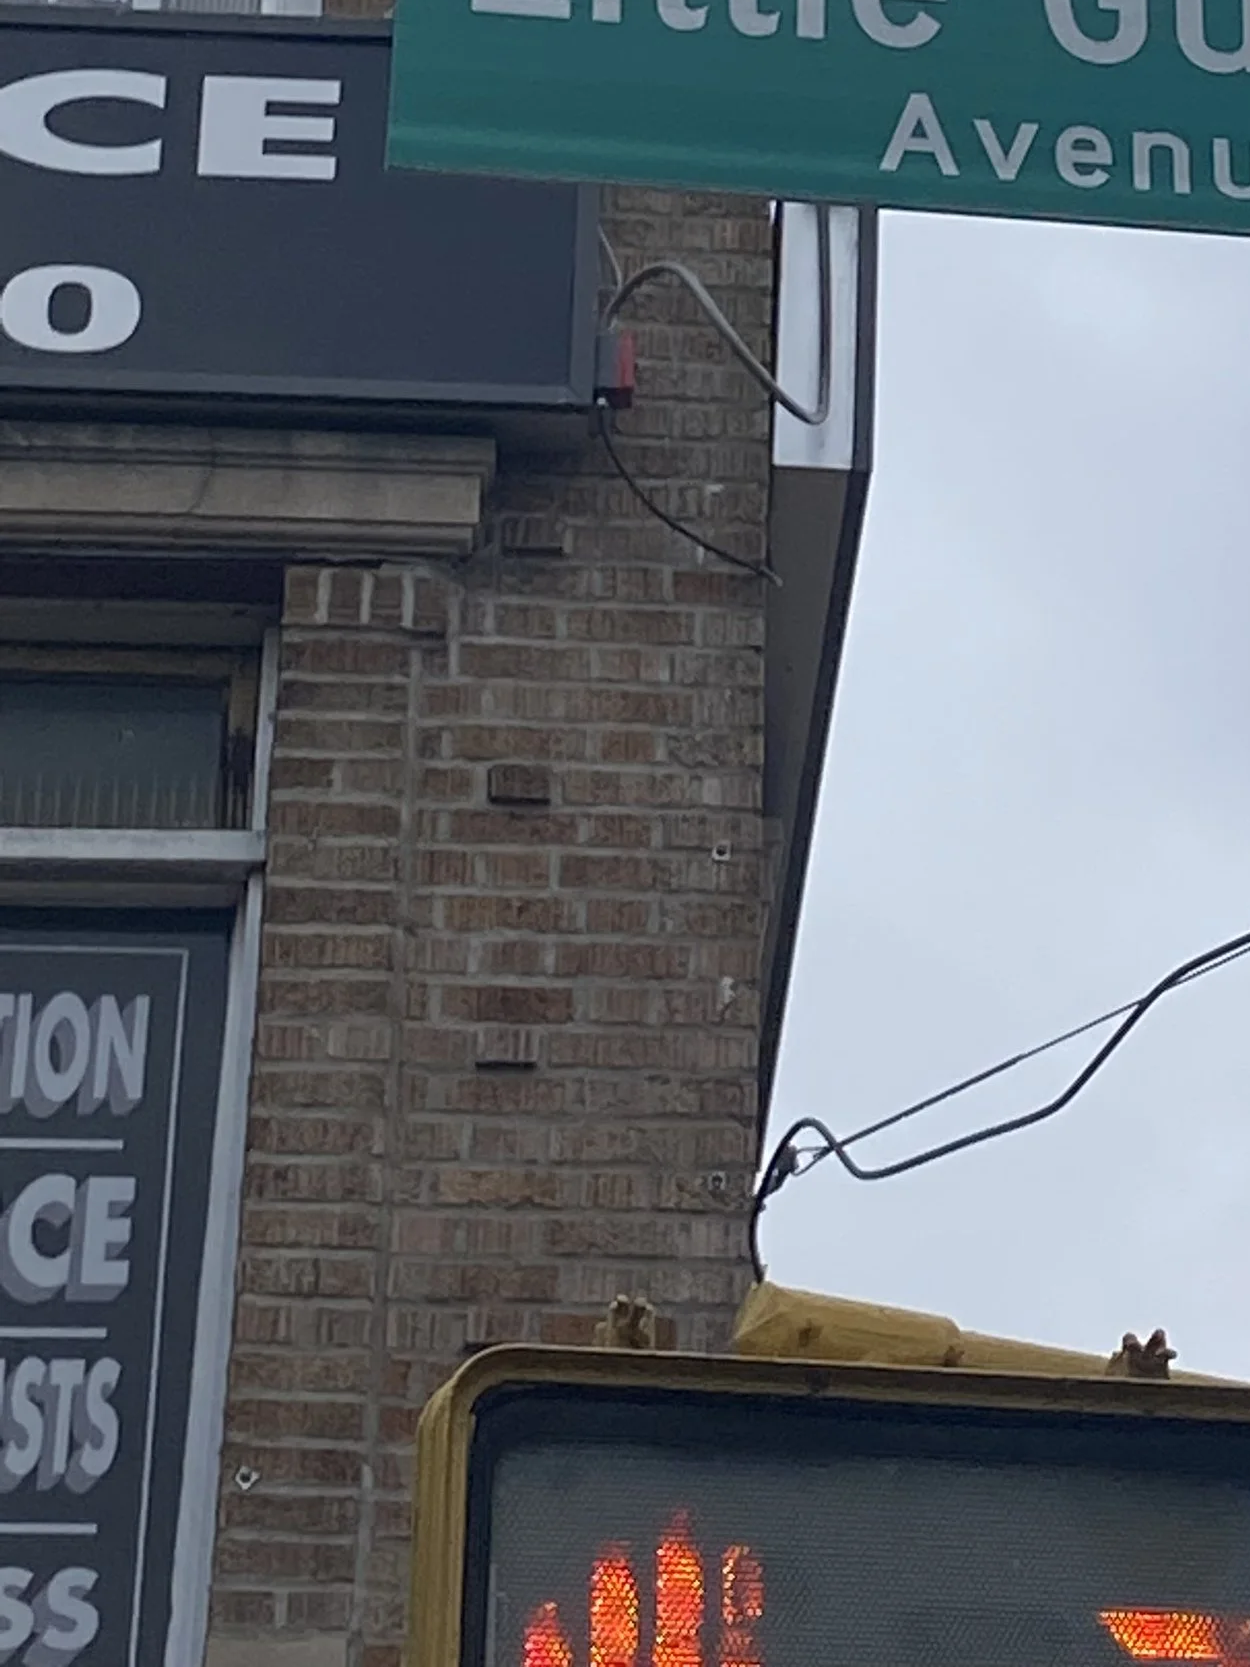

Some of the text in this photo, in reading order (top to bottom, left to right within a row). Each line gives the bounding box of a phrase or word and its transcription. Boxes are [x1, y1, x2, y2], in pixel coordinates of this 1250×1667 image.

[0, 68, 342, 180] CE
[7, 1172, 137, 1288] CE
[0, 1355, 122, 1477] STS
